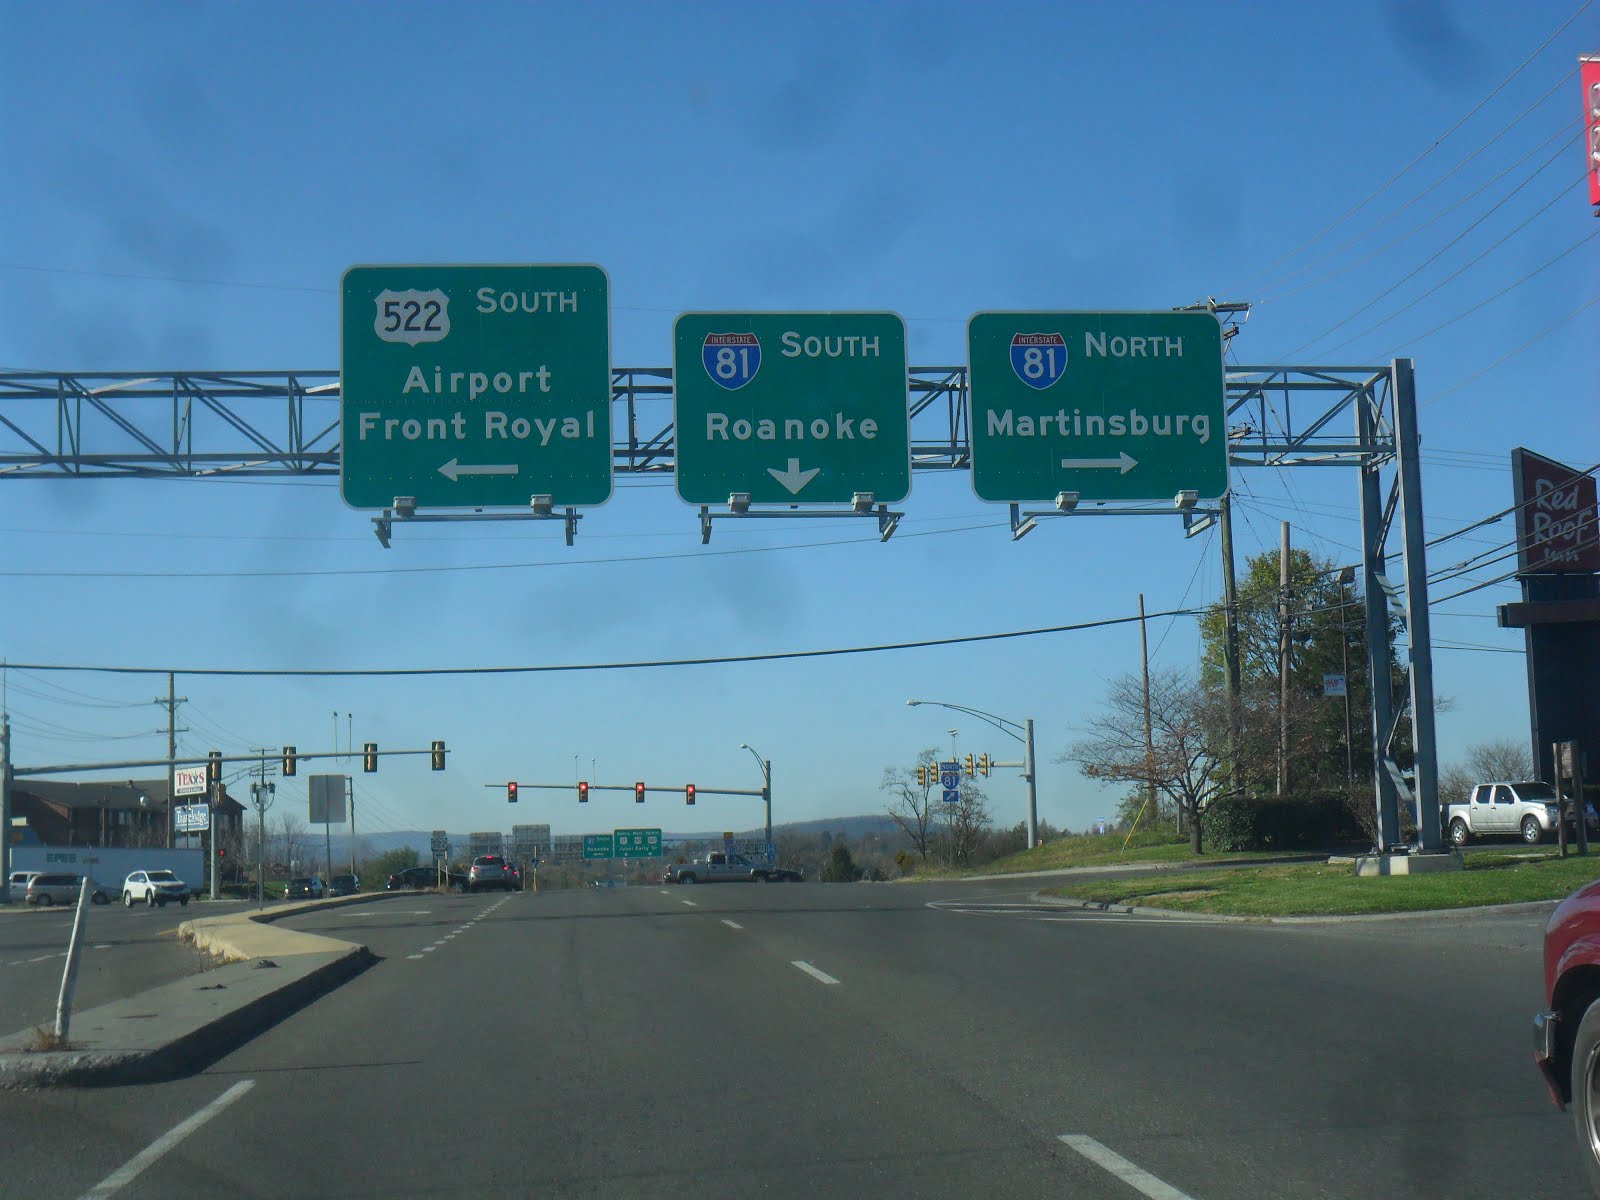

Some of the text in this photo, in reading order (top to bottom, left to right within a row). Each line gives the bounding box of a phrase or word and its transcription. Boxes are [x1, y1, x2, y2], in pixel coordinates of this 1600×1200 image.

[476, 287, 578, 314] SOUTH
[384, 301, 442, 333] 522
[711, 336, 752, 344] INTERSTATE
[780, 331, 880, 358] SOUTH
[1018, 336, 1058, 344] INTERSTATE
[1084, 331, 1184, 358] NORTH
[716, 347, 749, 379] 81
[1024, 347, 1056, 379] 81
[402, 365, 551, 401] Airport
[359, 409, 594, 447] Front Royal
[706, 411, 879, 441] Roanoke
[987, 408, 1210, 445] Martinsburg
[1535, 478, 1580, 511] Red
[1533, 508, 1593, 546] Roof
[945, 776, 955, 786] 81
[433, 841, 447, 849] 522
